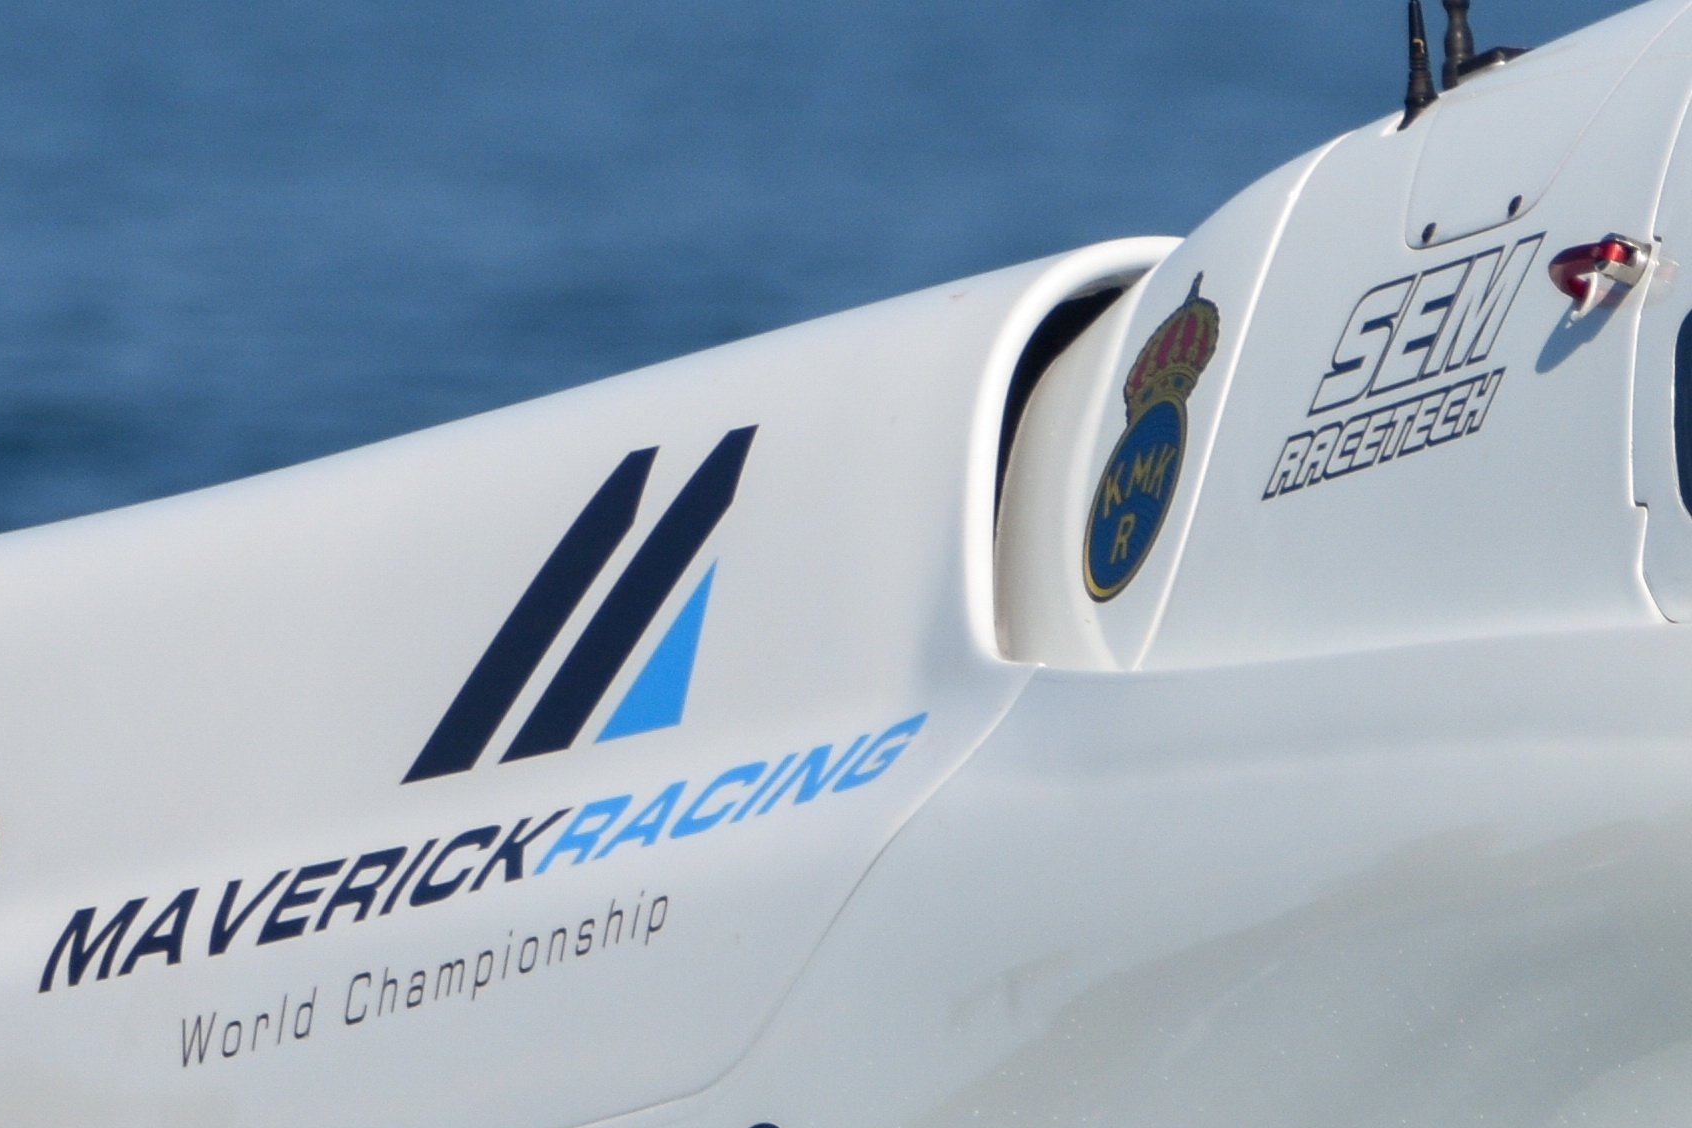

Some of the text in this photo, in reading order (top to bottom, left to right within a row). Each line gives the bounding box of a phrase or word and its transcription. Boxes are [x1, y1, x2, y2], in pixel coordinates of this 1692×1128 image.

[1306, 231, 1547, 417] SEM
[1261, 366, 1507, 500] RACETECH
[180, 890, 669, 1067] World Championship
